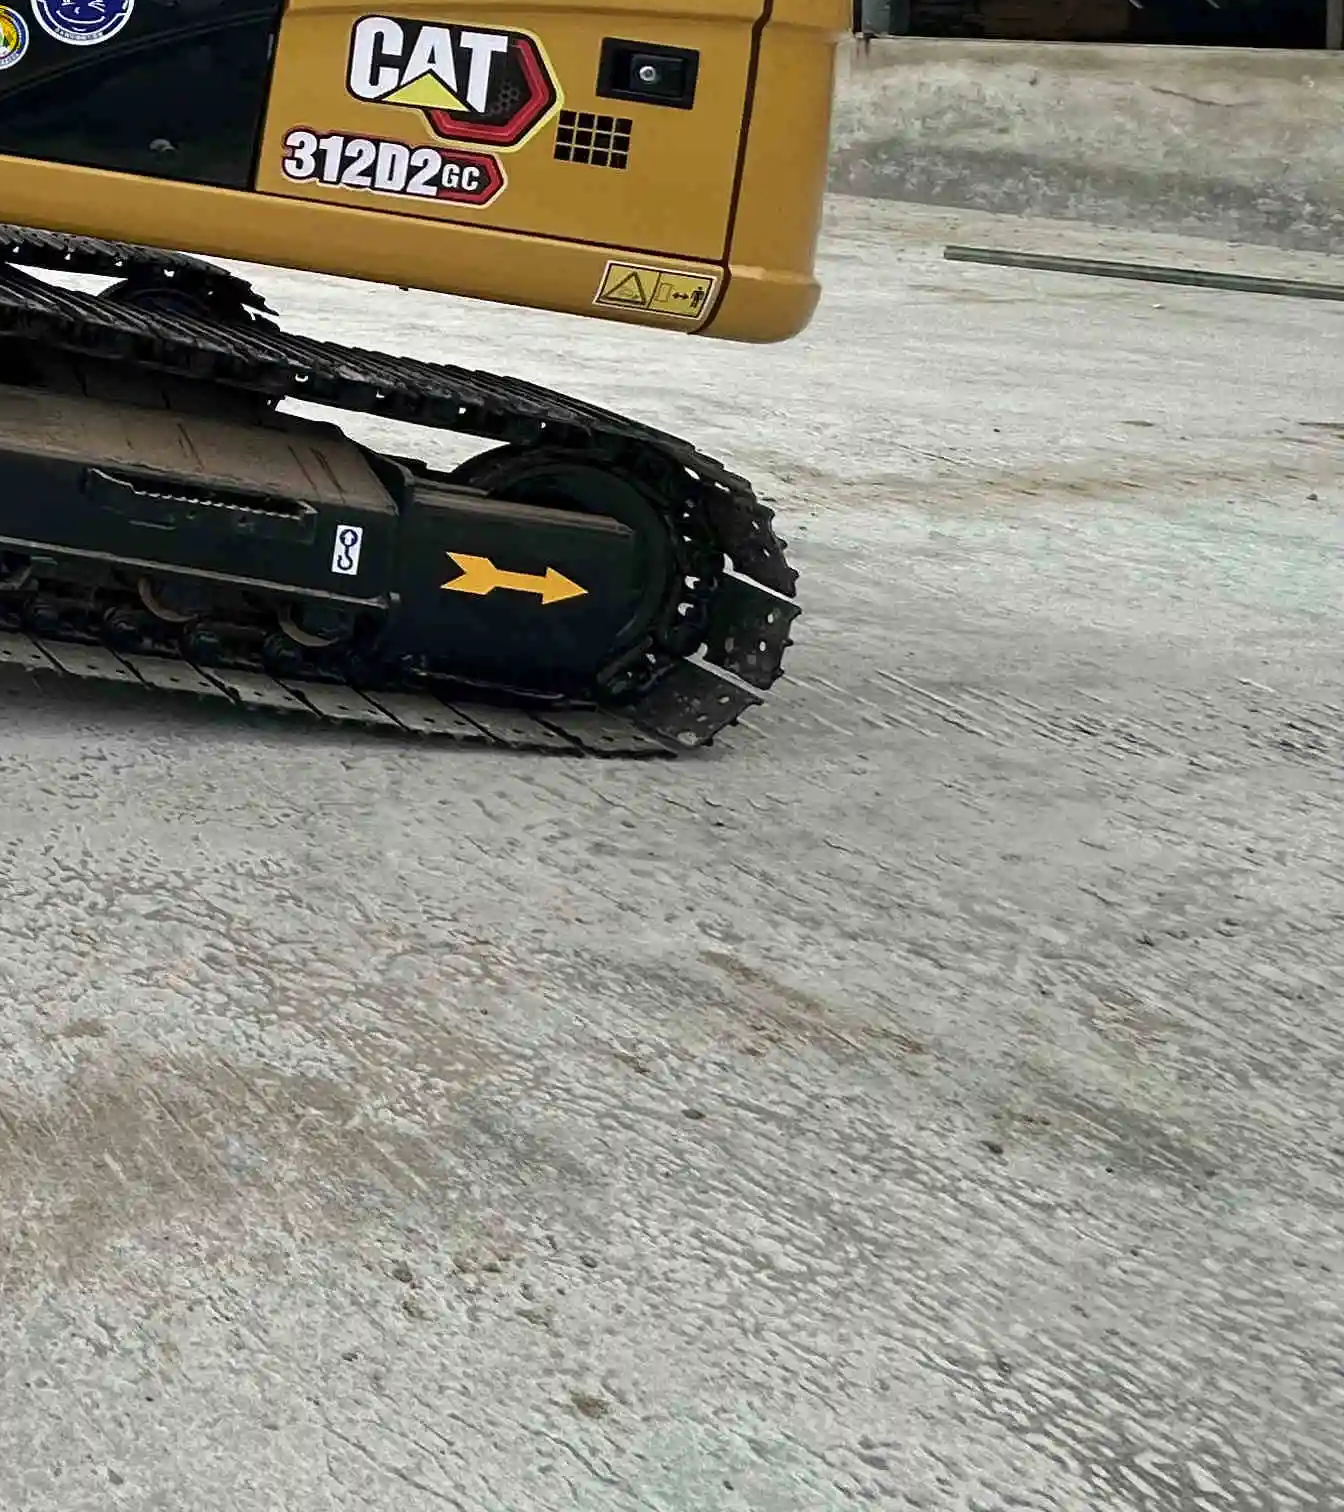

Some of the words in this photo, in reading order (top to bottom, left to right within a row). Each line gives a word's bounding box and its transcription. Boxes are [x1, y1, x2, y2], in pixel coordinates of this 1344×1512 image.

[349, 15, 509, 114] CAT
[283, 131, 442, 196] 312D2
[441, 162, 480, 192] GC
